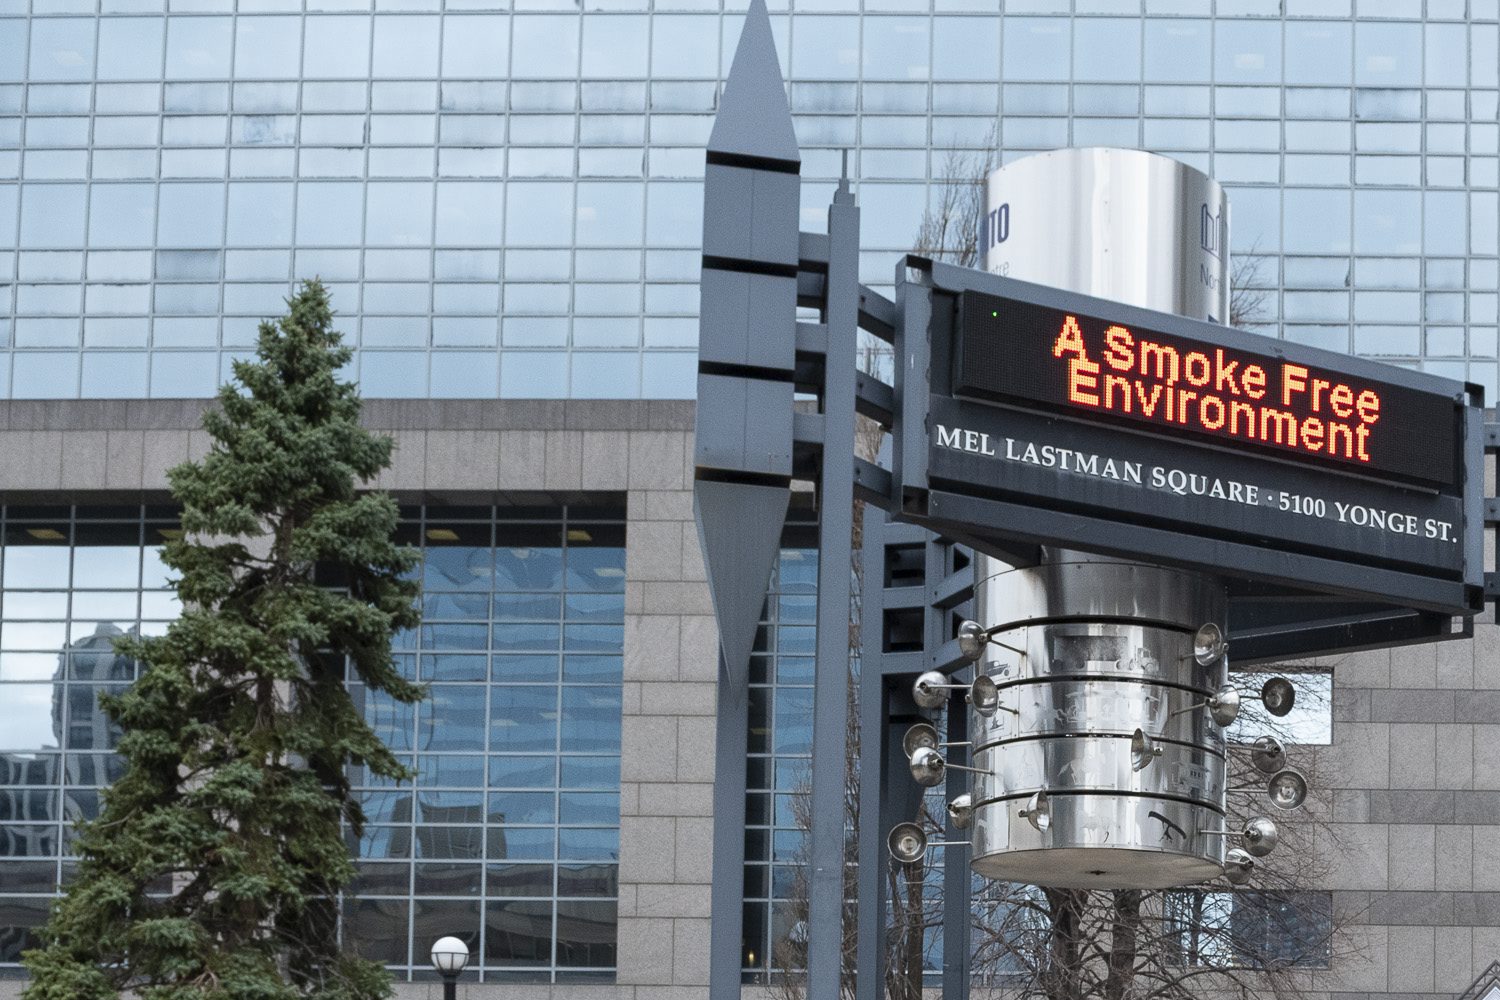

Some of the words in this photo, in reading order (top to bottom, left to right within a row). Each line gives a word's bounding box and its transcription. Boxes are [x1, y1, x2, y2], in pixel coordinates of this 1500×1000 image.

[1051, 315, 1087, 359] A
[1102, 325, 1266, 399] Smoke
[1281, 363, 1379, 423] Free
[1068, 357, 1371, 461] Environment
[936, 424, 995, 456] MEL
[1005, 437, 1143, 484] LASTMAN
[1151, 466, 1259, 506] SQUARE
[1279, 491, 1326, 518] 5100
[1335, 501, 1418, 535] YONGE
[1424, 518, 1458, 543] ST.
